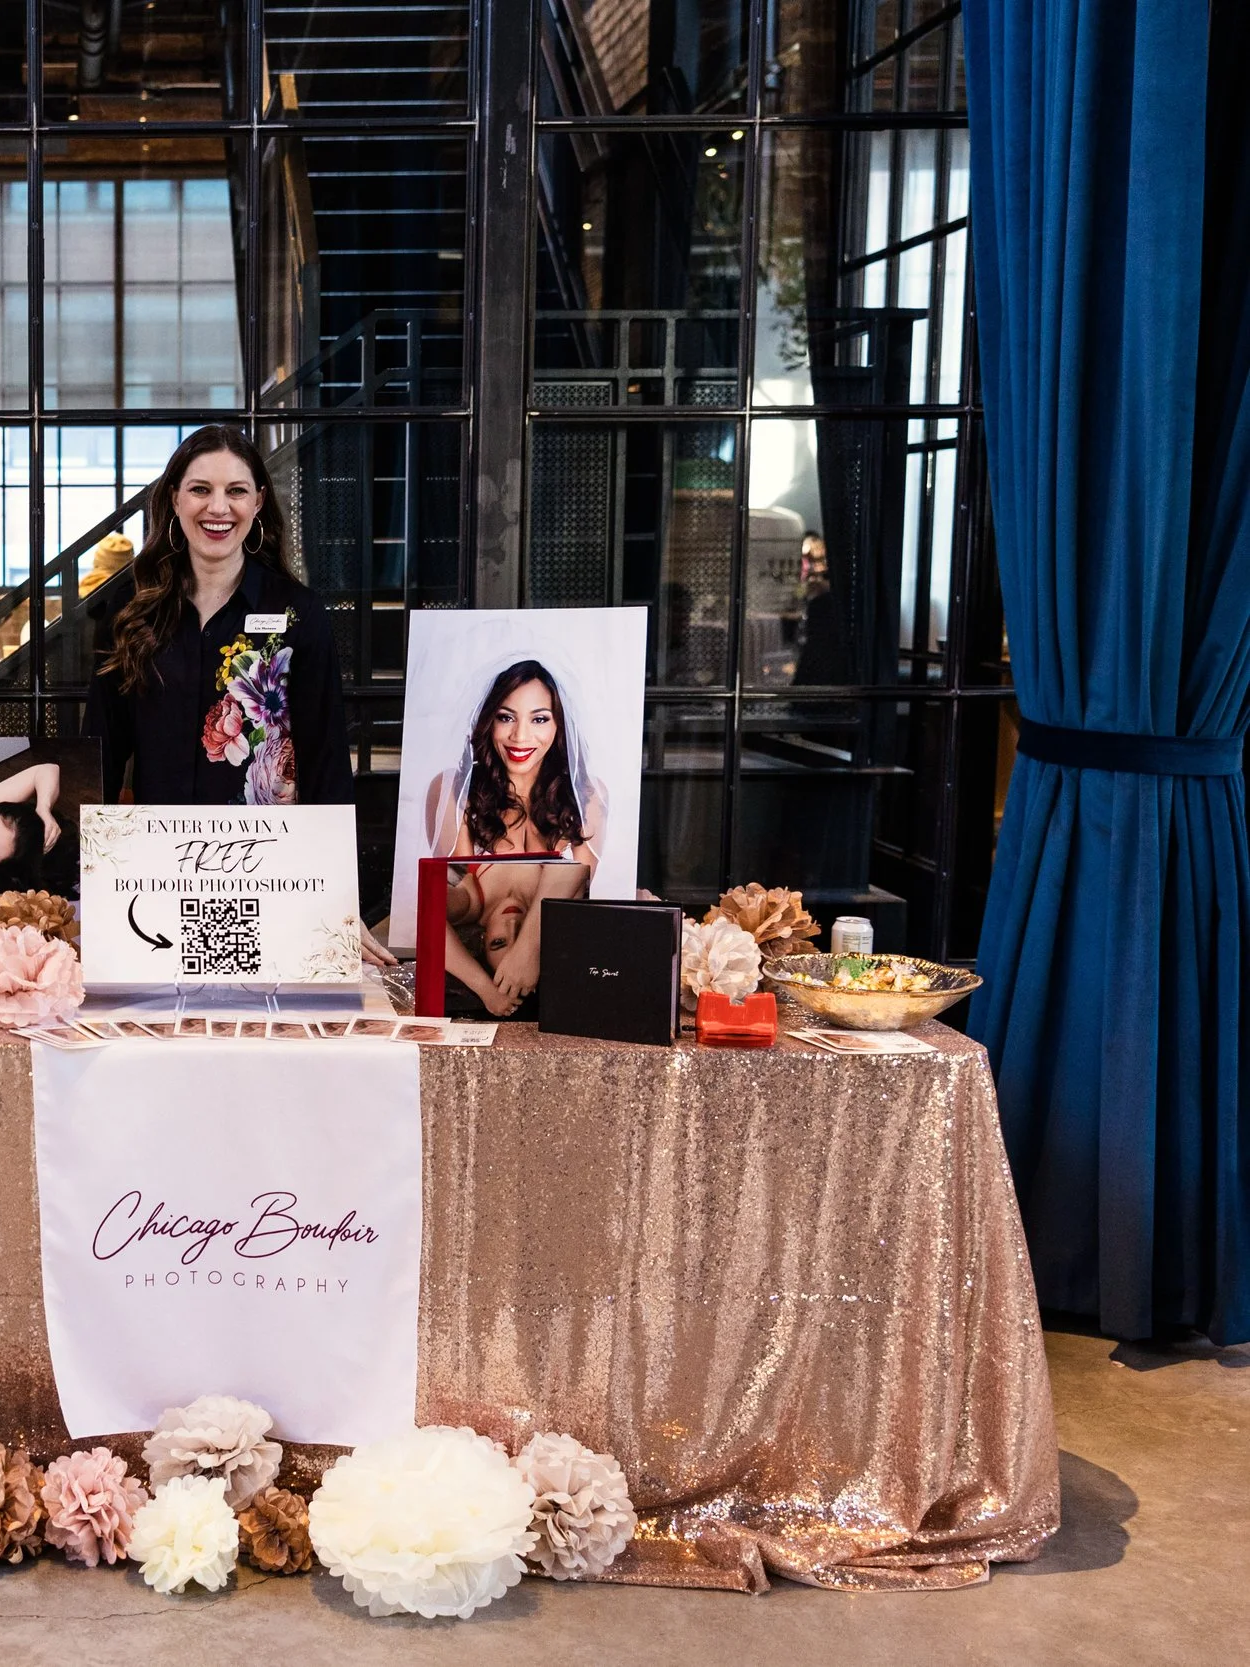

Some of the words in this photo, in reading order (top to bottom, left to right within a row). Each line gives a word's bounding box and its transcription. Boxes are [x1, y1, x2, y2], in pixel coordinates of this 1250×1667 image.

[146, 819, 203, 834] ENTER
[207, 819, 233, 834] TO
[238, 819, 273, 834] WIN
[278, 820, 290, 834] A
[175, 838, 278, 874] FREE
[115, 878, 193, 893] BOUDOIR
[199, 878, 325, 893] PHOTOSHOOT!
[589, 967, 599, 976] Top
[92, 1190, 240, 1265] Chicago
[234, 1191, 380, 1259] Boudoir
[124, 1270, 350, 1294] PHOTOGRAPHY
